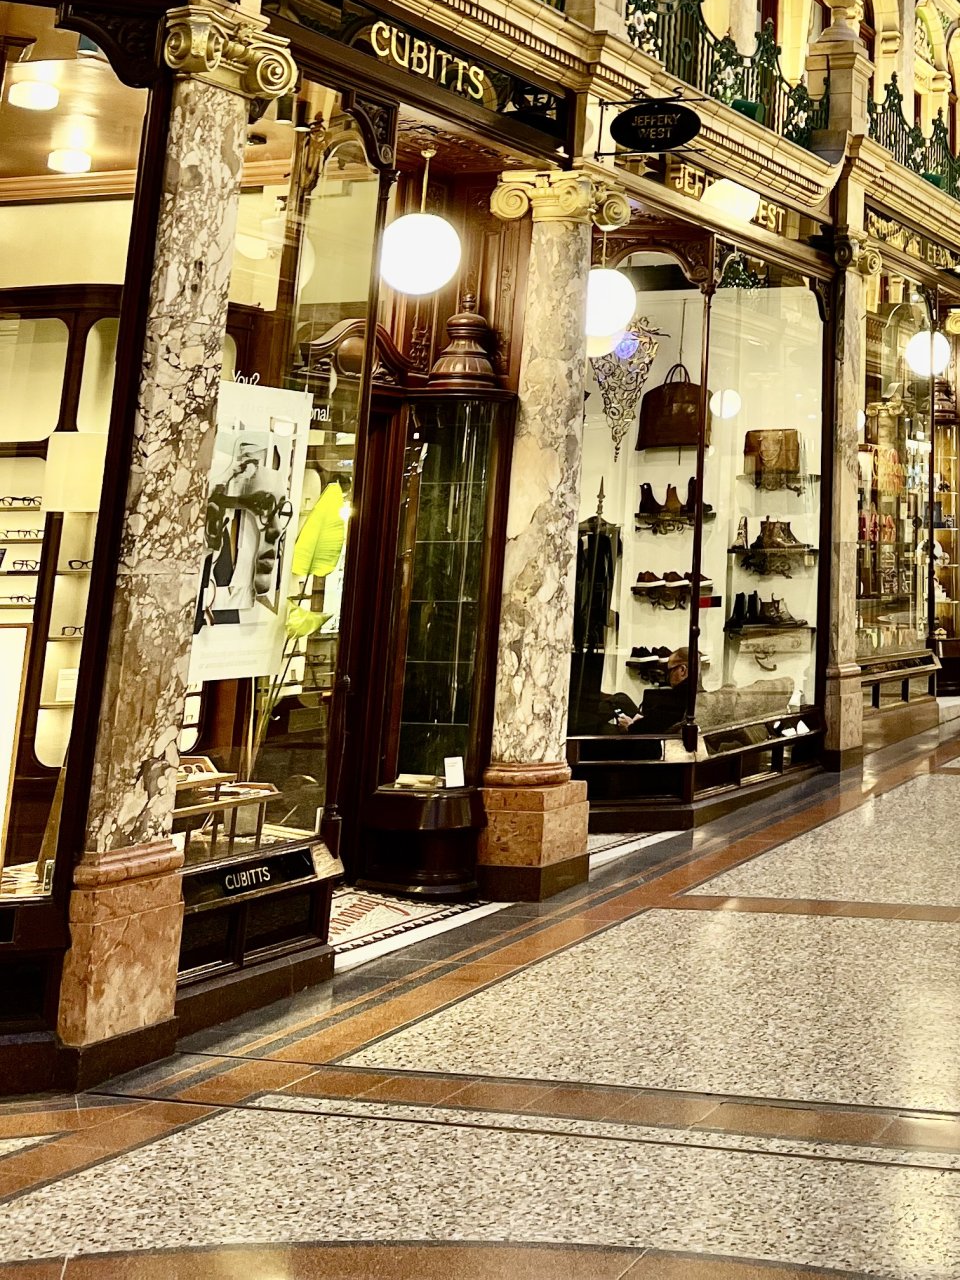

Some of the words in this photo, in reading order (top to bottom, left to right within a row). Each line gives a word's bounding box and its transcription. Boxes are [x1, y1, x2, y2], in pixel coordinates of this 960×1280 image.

[370, 20, 484, 100] CUBITTS
[631, 113, 681, 127] JEFFERY
[638, 127, 673, 139] WEST
[753, 199, 786, 232] EST
[232, 369, 260, 386] You?
[225, 866, 271, 890] CUBITTS
